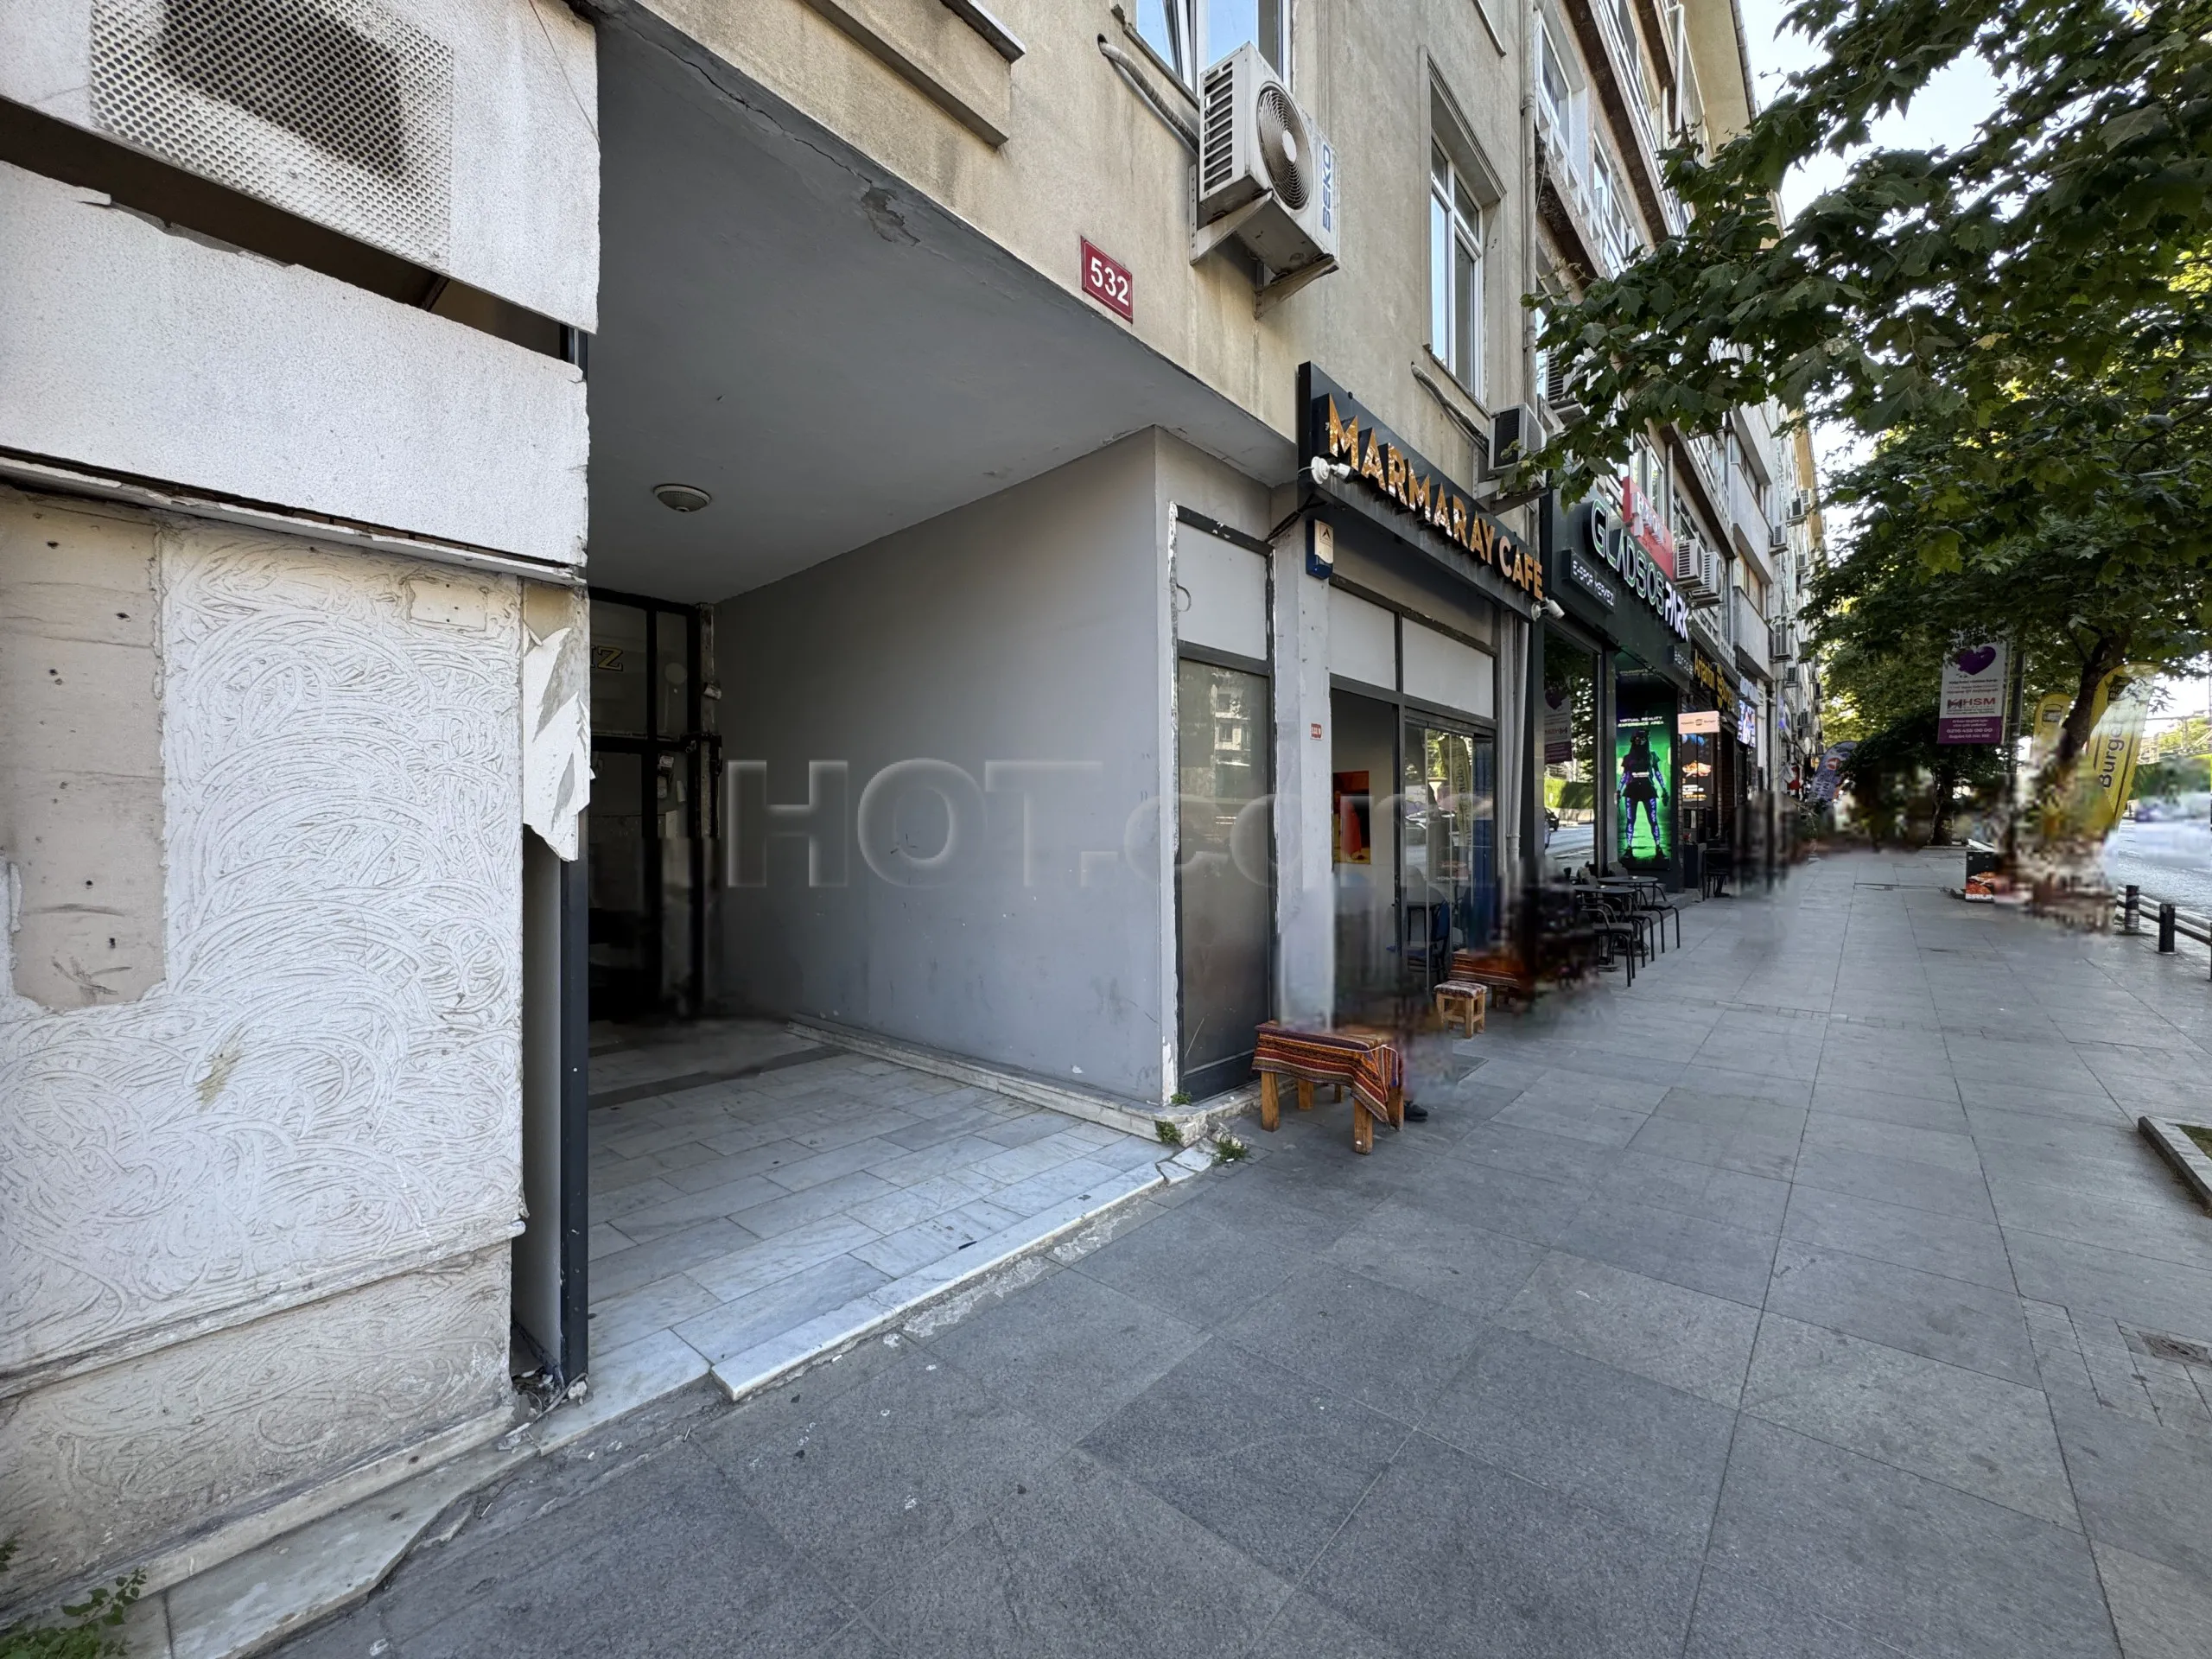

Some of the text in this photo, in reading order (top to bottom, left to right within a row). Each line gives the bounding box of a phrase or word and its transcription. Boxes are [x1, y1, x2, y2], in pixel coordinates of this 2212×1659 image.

[1322, 143, 1332, 233] BEKO
[1090, 256, 1129, 307] 532
[1329, 392, 1496, 566] MARMARAY
[1498, 535, 1543, 601] CAFE
